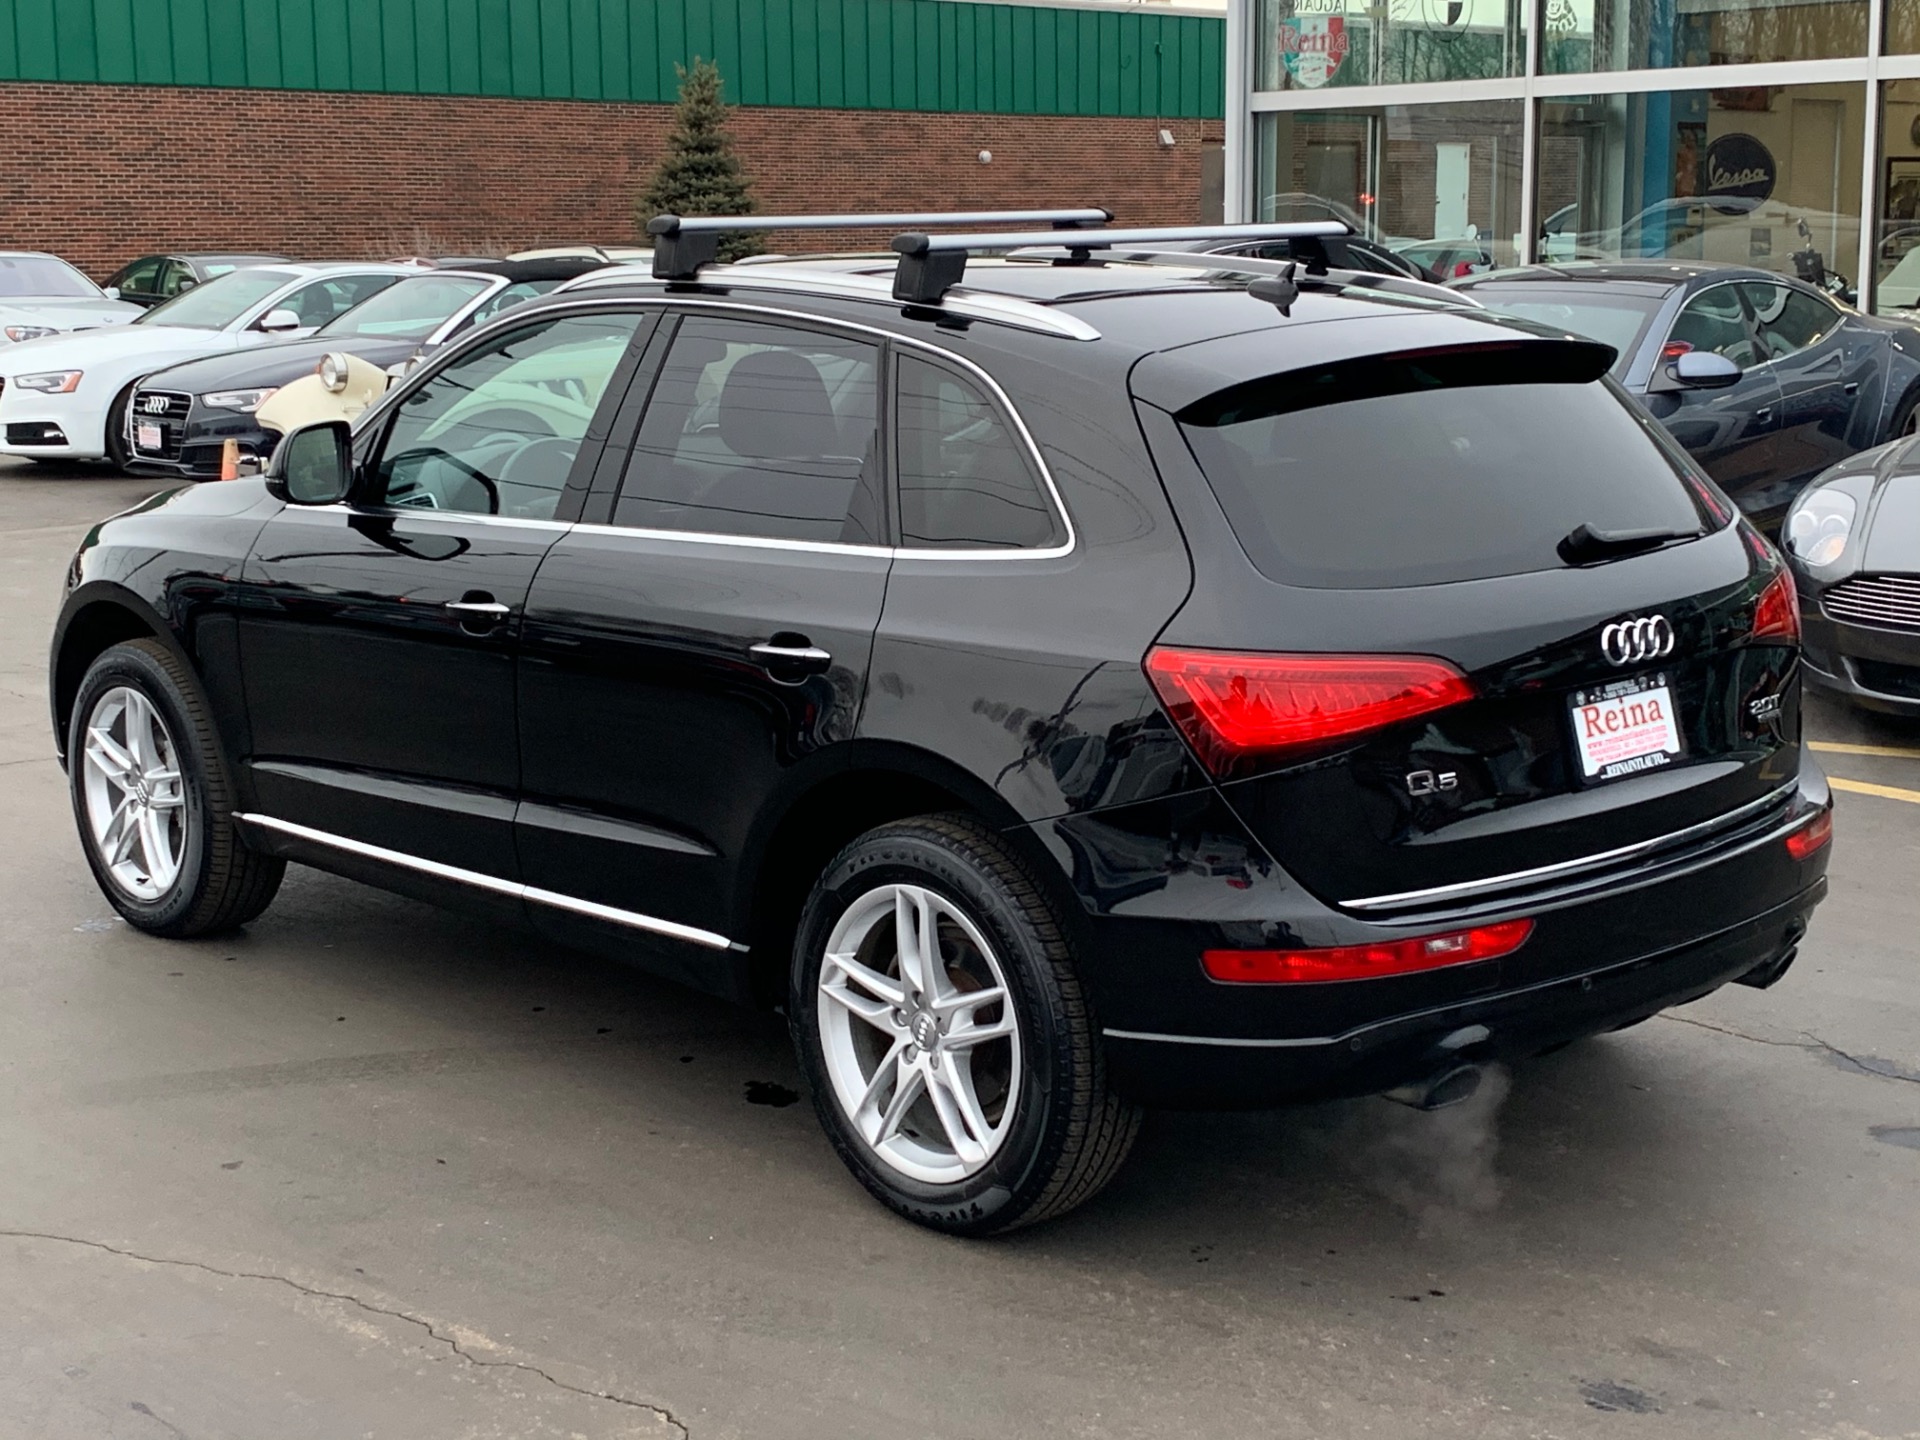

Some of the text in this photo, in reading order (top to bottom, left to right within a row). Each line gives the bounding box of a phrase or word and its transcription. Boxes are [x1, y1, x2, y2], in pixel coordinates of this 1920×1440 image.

[1279, 24, 1350, 53] Reina
[1708, 154, 1769, 190] Vespa
[1582, 697, 1664, 738] Reina
[1406, 770, 1458, 796] Q5
